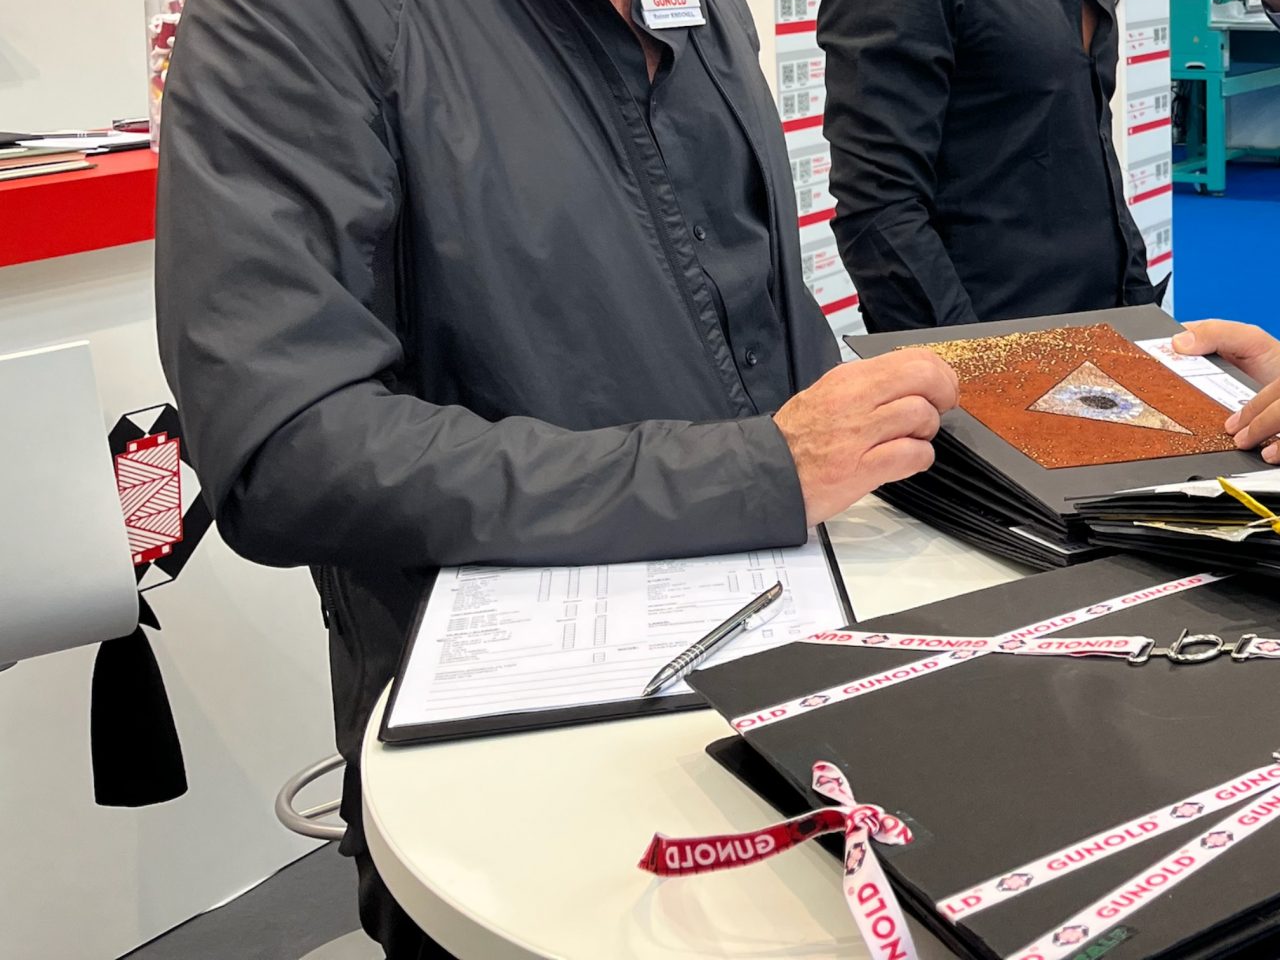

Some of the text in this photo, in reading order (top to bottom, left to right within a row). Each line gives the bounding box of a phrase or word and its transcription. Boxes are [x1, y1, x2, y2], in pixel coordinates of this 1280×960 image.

[1121, 576, 1203, 605] GUNOLD
[899, 637, 988, 649] GUNOLD
[1037, 639, 1129, 650] GUNOLD
[843, 660, 939, 695] GUNOLD
[1047, 821, 1159, 871] GUNOLD
[1096, 854, 1196, 919] GUNOLD
